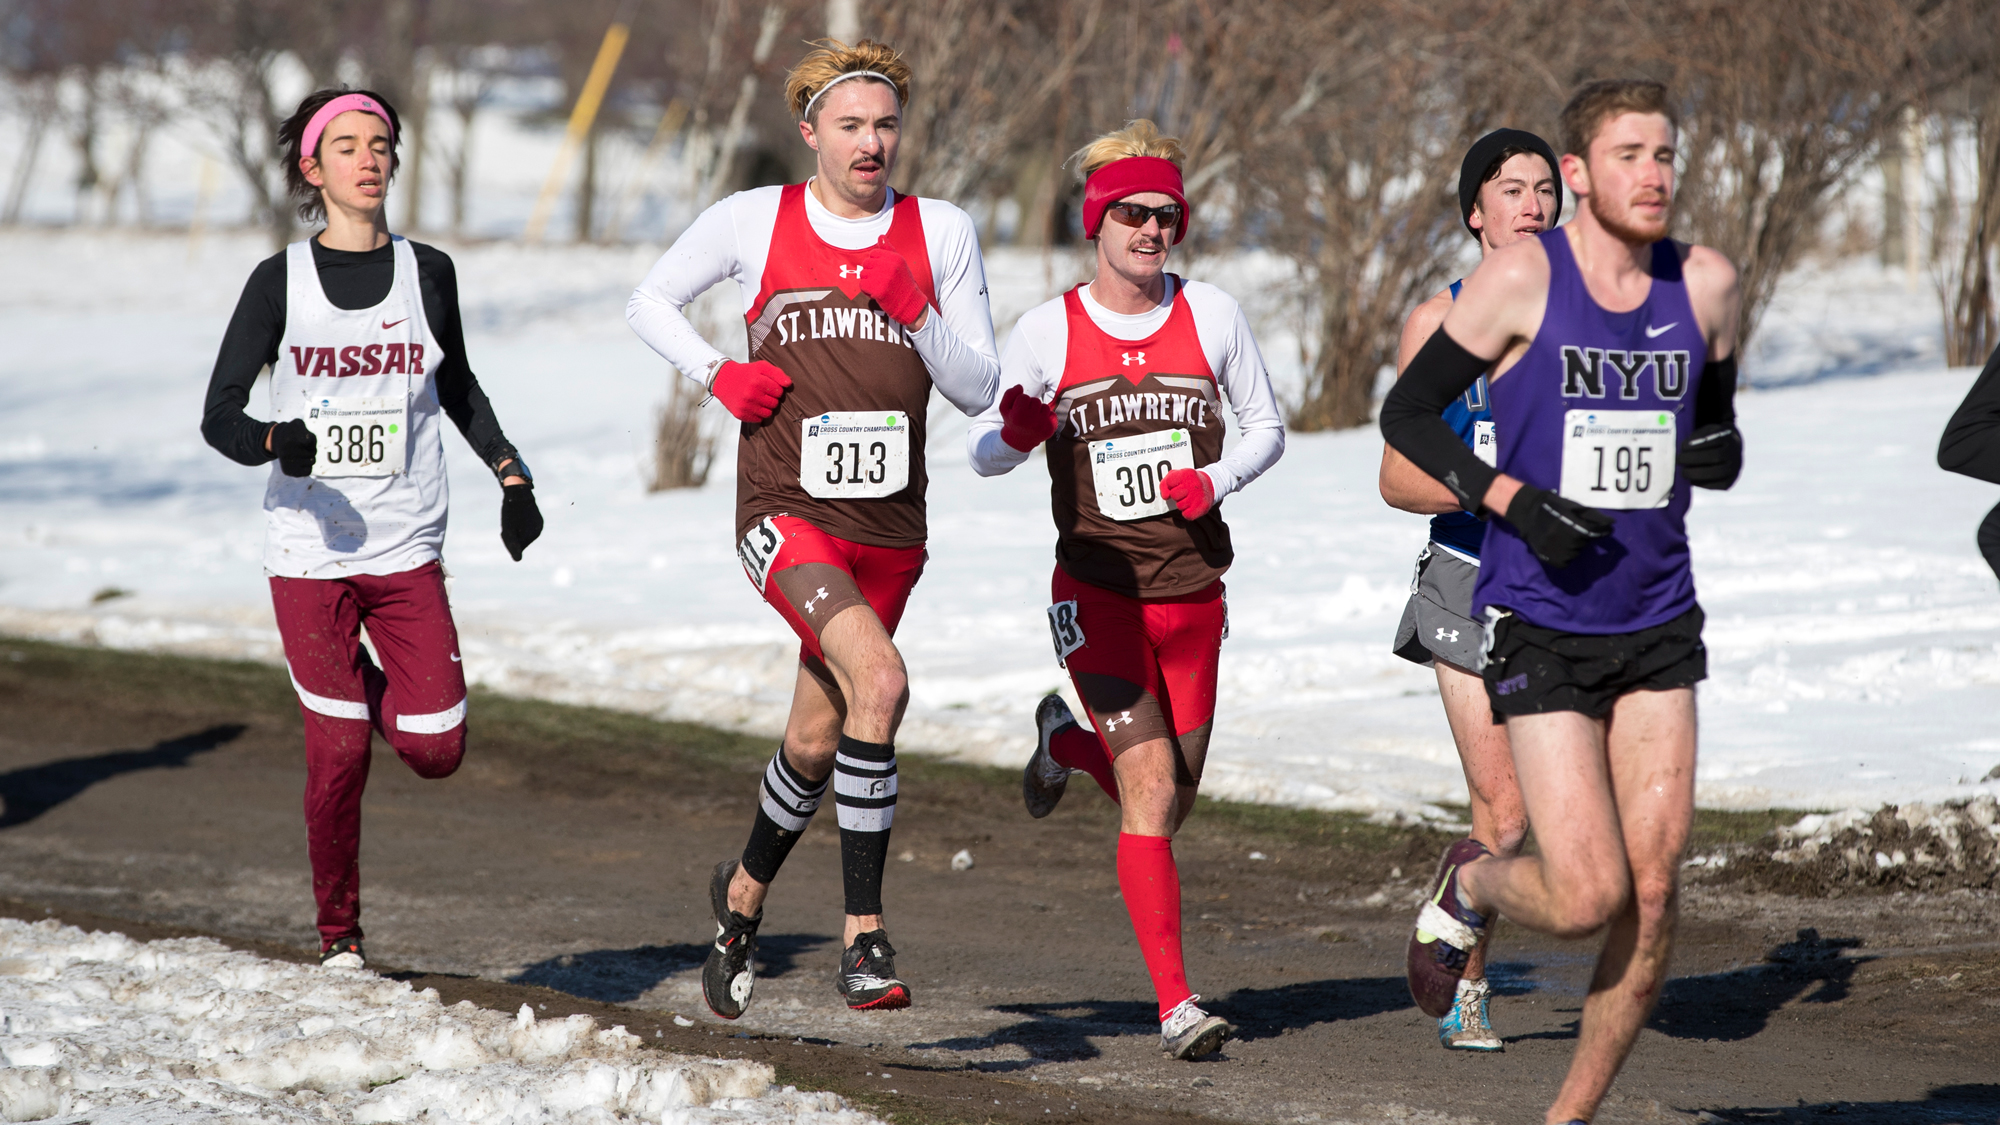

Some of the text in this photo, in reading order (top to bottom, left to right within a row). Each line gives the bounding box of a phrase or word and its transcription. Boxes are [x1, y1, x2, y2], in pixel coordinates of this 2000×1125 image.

[776, 310, 806, 346] ST.
[289, 342, 425, 378] VASSAR
[1560, 345, 1690, 401] NYU
[362, 408, 403, 416] CHAMPIONSHIPS
[863, 425, 905, 433] CHAMPIONSHIPS
[1069, 392, 1207, 438] ST. LAWRENCE
[327, 424, 384, 464] 386
[826, 441, 887, 484] 313
[1106, 440, 1188, 460] CROSS COUNTRY CHAMPIONSHIPS
[1590, 446, 1653, 492] 195
